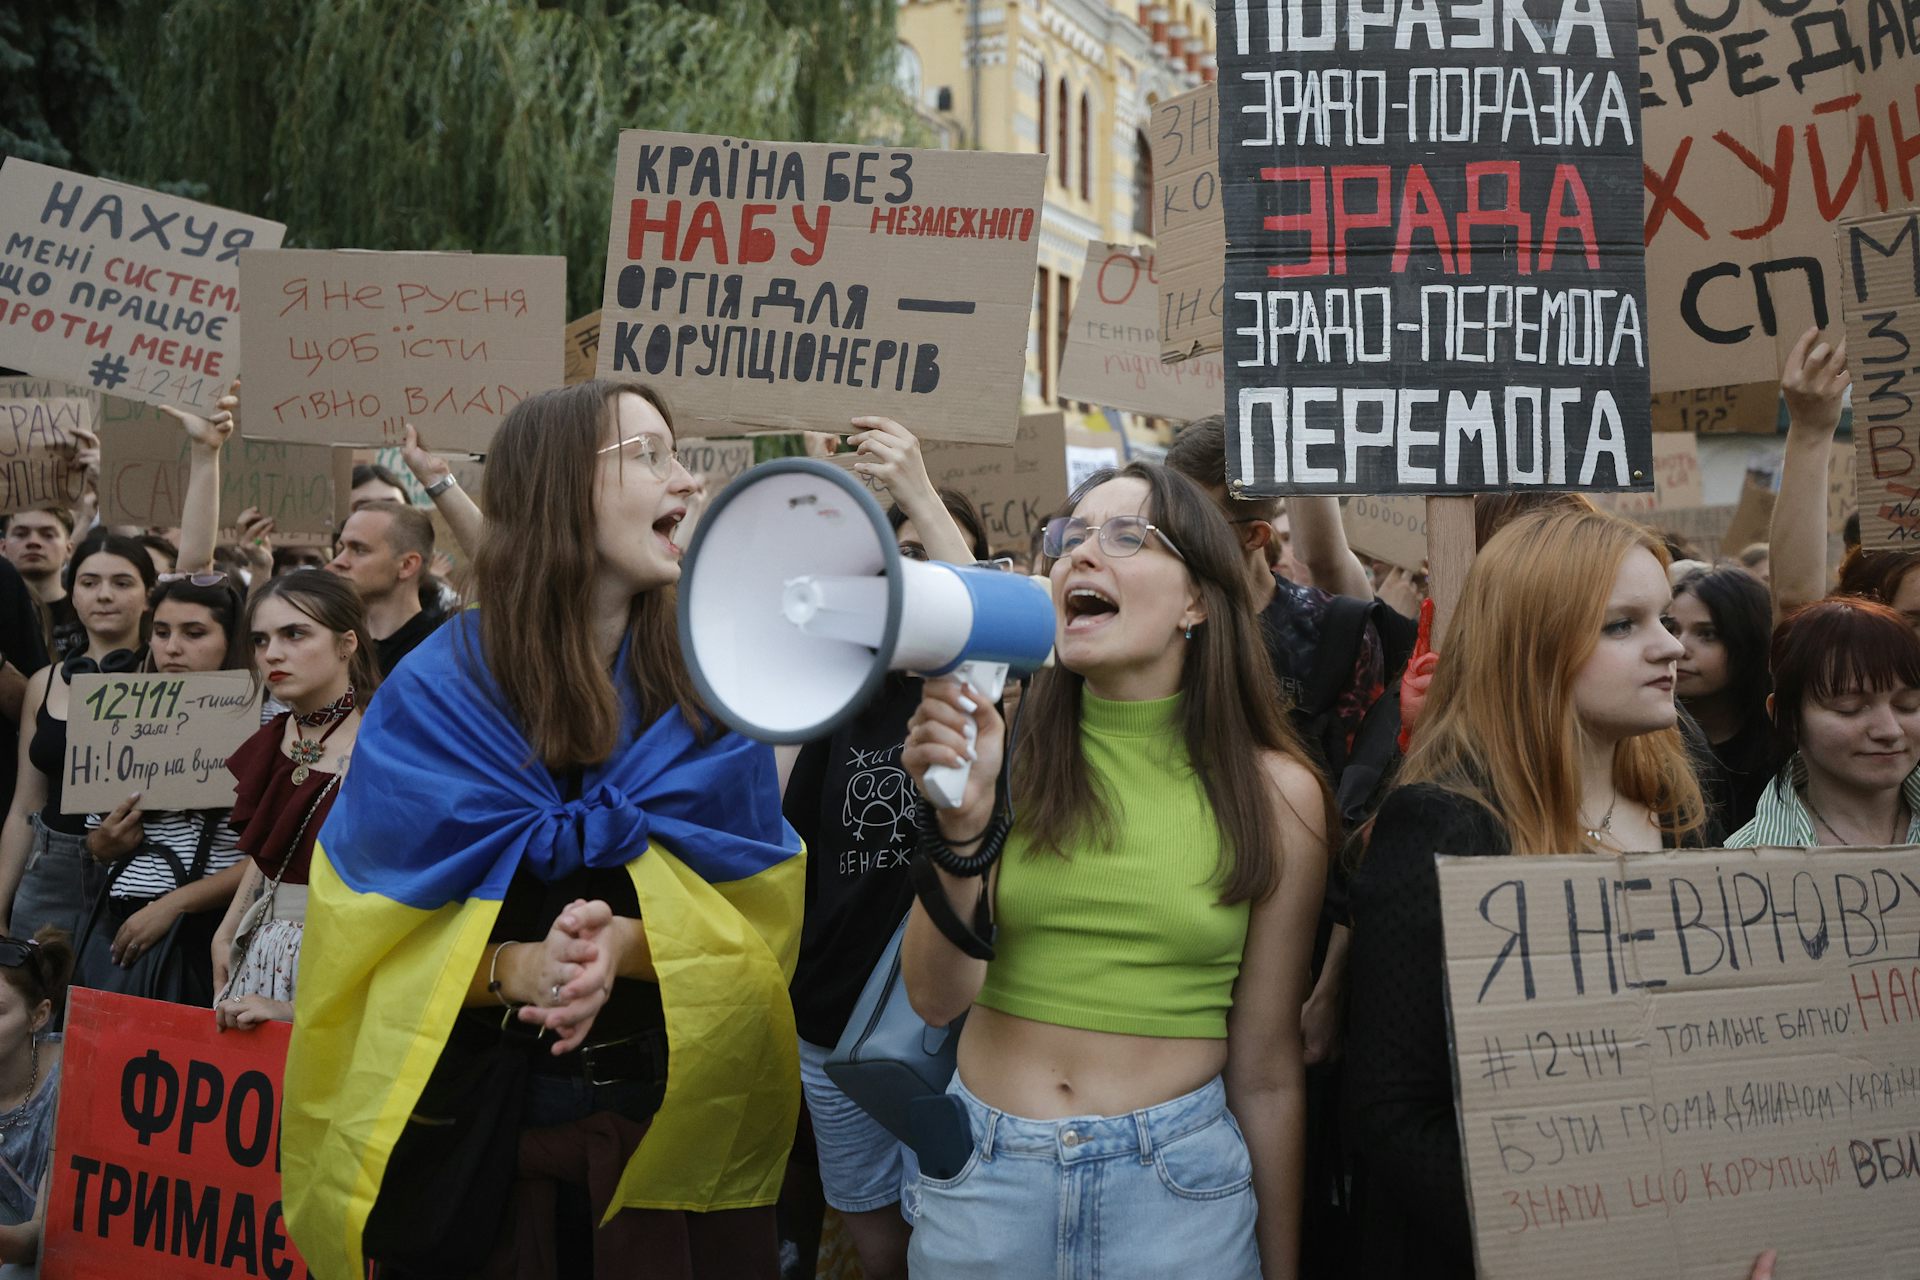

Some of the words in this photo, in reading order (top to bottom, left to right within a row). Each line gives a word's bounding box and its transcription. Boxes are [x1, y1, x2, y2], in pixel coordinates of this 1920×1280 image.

[636, 139, 805, 201] КРАЇНА
[823, 151, 913, 204] БЕЗ
[40, 181, 254, 266] НАХУЯ
[627, 198, 831, 266] НАБУ
[870, 206, 1034, 242] НЕЗАЛЕЖНОГО
[5, 232, 95, 273] МЕНІ
[104, 258, 240, 312] СИСТЕМ
[280, 278, 307, 317] Я
[617, 265, 743, 320] ОРГІЯ
[752, 278, 869, 330] ДЛЯ
[69, 282, 228, 341] ПРАЦЮЄ
[129, 334, 224, 377] МЕНЕ
[289, 333, 379, 376] ЩОБ
[393, 325, 487, 361] ЇСТИ
[613, 321, 940, 394] КОРУПЦІОНЕРІВ
[273, 390, 380, 424] ГІВНО
[405, 385, 530, 416] ВЛАД
[1238, 386, 1630, 486] ПЕРЕМОГА
[86, 680, 185, 721] 12414
[117, 745, 159, 790] Опір
[164, 757, 186, 776] на
[1474, 880, 1536, 1003] Я
[1564, 877, 1667, 995] НЕ
[1669, 867, 1829, 975] ВІРЮ
[1480, 1028, 1622, 1090] #12414
[1657, 1016, 1768, 1057] ТОТАЛЬНЕ
[120, 1048, 283, 1174] ФРО
[1491, 1115, 1604, 1174] БУТИ
[1621, 1082, 1835, 1141] ГРОМАДЯНИНОМ
[1836, 1062, 1920, 1114] УКРАЇН
[70, 1154, 313, 1280] ТРИМАЄ
[1502, 1183, 1608, 1235] ЗНАТИ
[1628, 1168, 1688, 1219] ЩО
[1701, 1142, 1840, 1200] КОРУПЦІЯ
